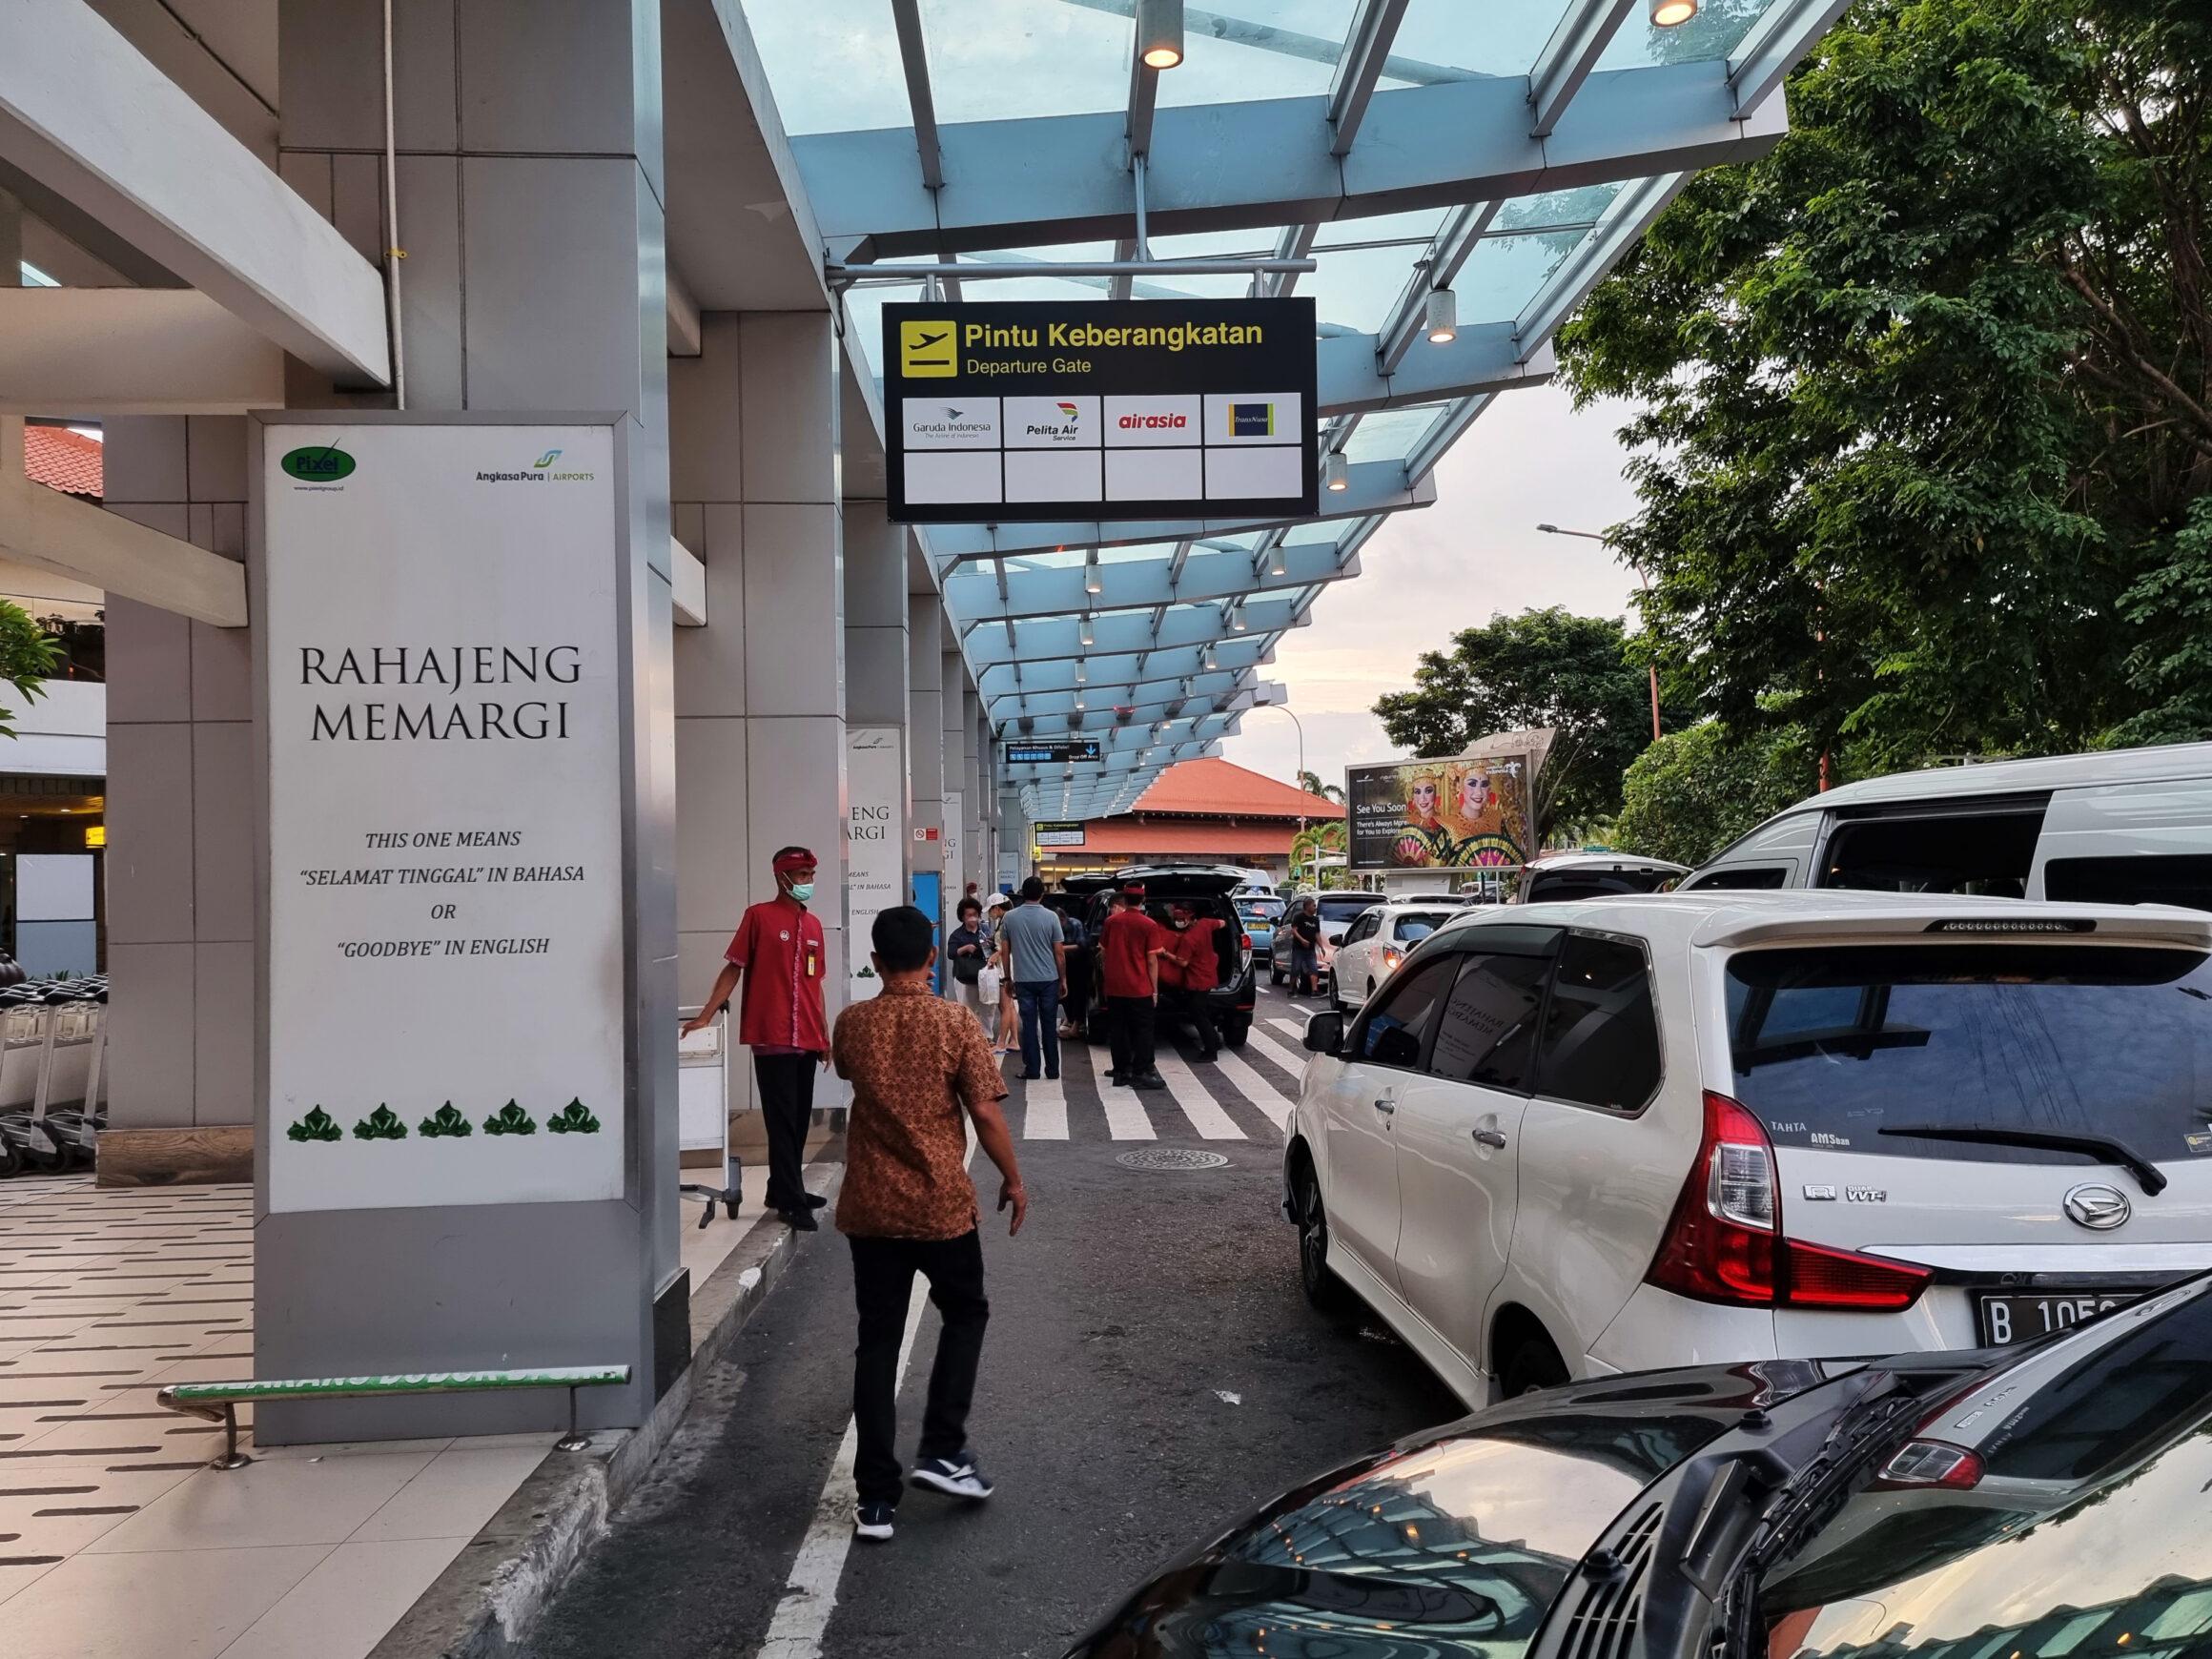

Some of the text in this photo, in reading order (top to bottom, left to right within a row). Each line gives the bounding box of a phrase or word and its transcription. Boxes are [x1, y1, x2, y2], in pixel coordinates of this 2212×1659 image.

[965, 322, 1262, 352] Pintu Keberangkatan
[967, 358, 1092, 377] Departure Gate
[913, 422, 991, 433] Garuda Indonesia
[1118, 413, 1187, 429] airasia
[1026, 425, 1078, 436] Pelita Air
[297, 455, 338, 471] Pixel
[298, 645, 582, 694] RAHAJENG
[310, 702, 569, 741] MEMARGI
[1357, 802, 1406, 814] See You Soon
[365, 830, 522, 849] THIS ONE MEANS
[486, 867, 508, 883] IN
[512, 866, 585, 882] BAHASA
[430, 904, 457, 920] OR
[443, 940, 465, 955] IN
[469, 938, 549, 954] ENGLISH
[1771, 1120, 1807, 1133] TAHTA
[1812, 1132, 1851, 1146] AMSban
[1991, 1300, 2117, 1344] B 105
